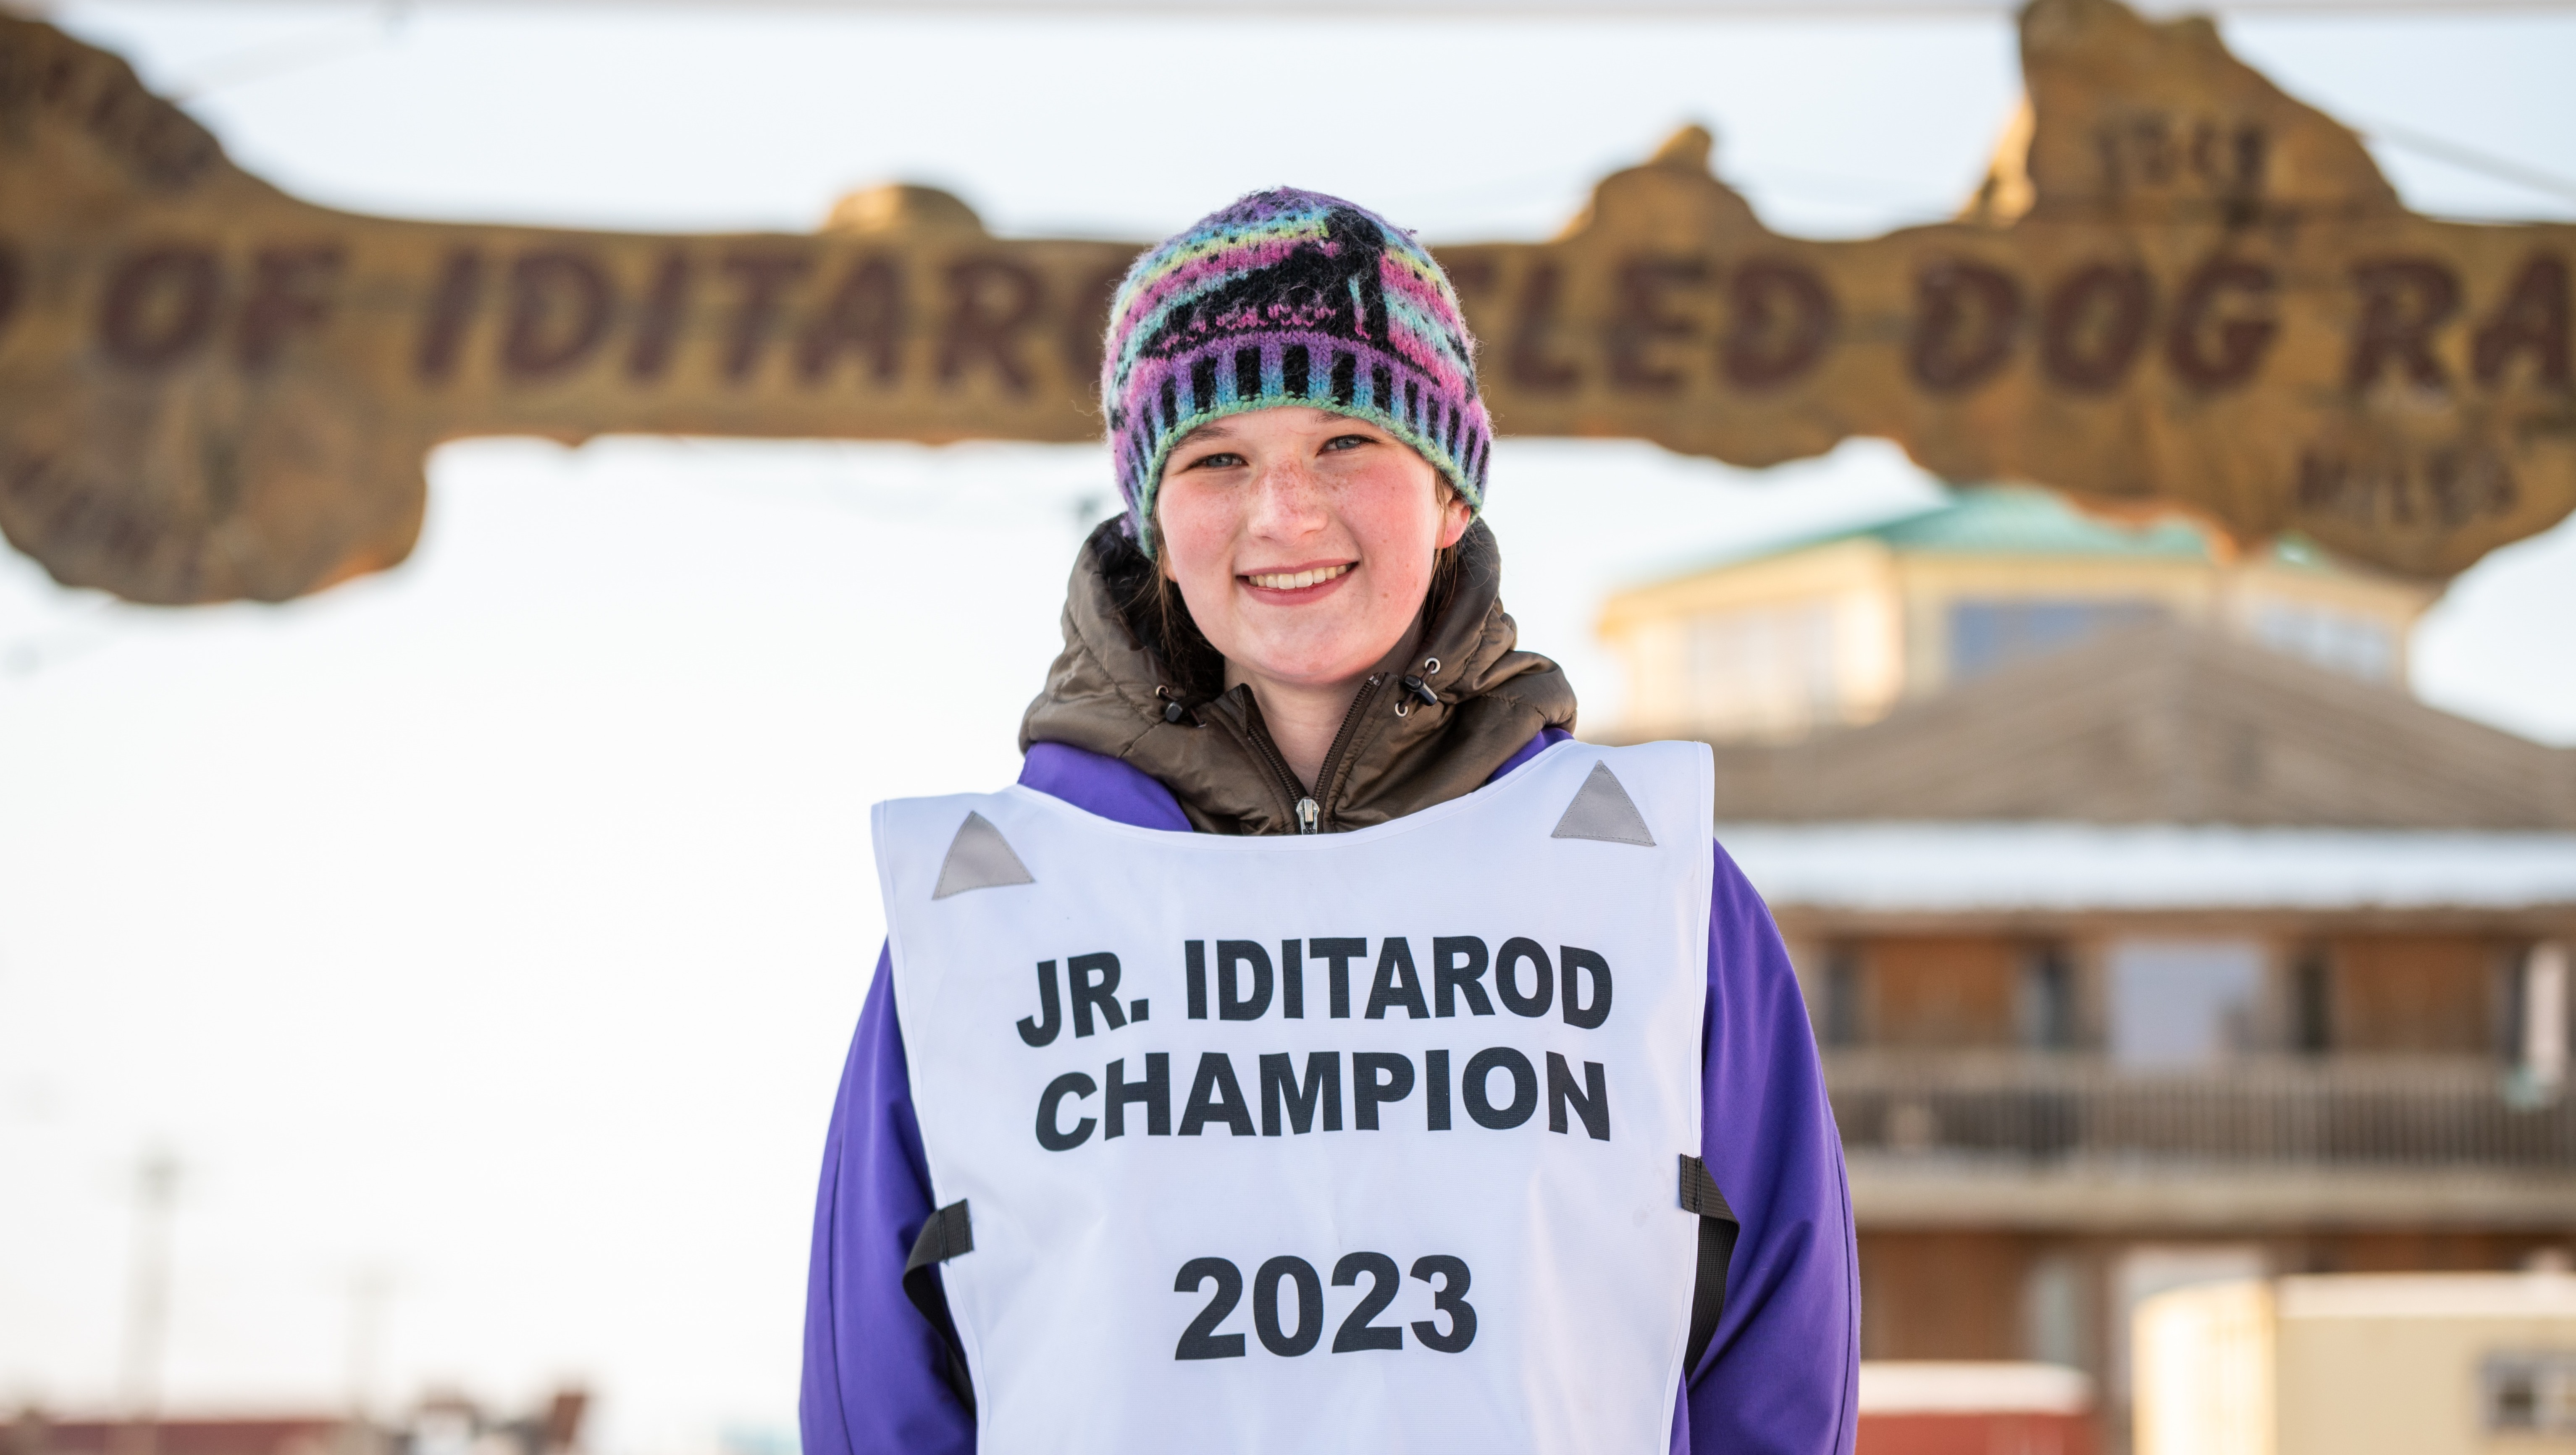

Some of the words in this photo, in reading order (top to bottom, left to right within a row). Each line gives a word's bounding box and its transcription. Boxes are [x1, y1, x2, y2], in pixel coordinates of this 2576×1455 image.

[99, 239, 348, 380] OF
[1906, 253, 2282, 400] DOG
[1017, 953, 1148, 1047] JR.
[1185, 936, 1612, 1029] IDITAROD
[1036, 1047, 1610, 1151] CHAMPION
[1174, 1252, 1477, 1360] 2023
